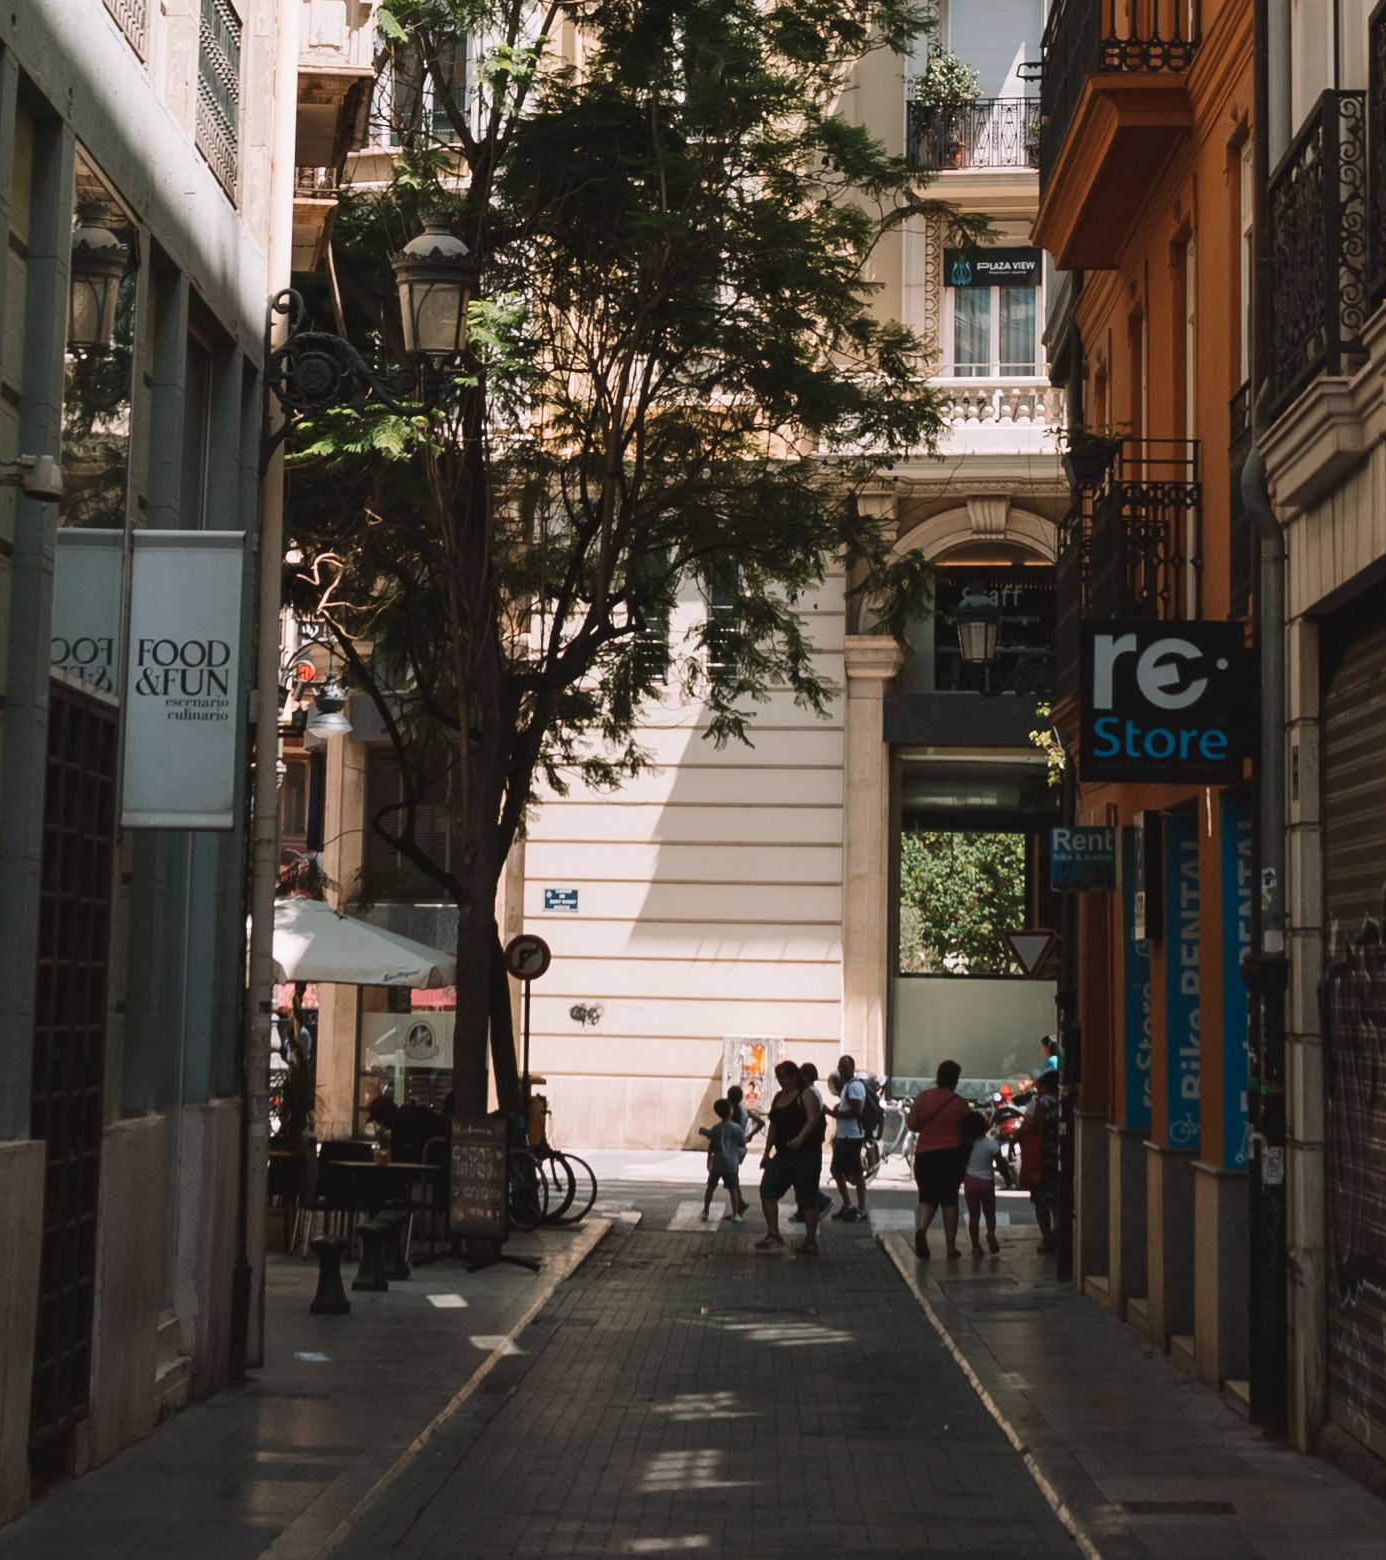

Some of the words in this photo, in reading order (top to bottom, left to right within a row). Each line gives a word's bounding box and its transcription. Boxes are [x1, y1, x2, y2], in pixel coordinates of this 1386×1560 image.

[977, 262, 1011, 270] PLAZA
[1013, 262, 1035, 270] VIEW
[138, 639, 231, 667] FOOD
[135, 666, 229, 696] &FUN
[165, 695, 230, 708] escenario
[167, 709, 229, 721] culinario
[1093, 716, 1228, 760] Store
[1053, 827, 1113, 850] Rent
